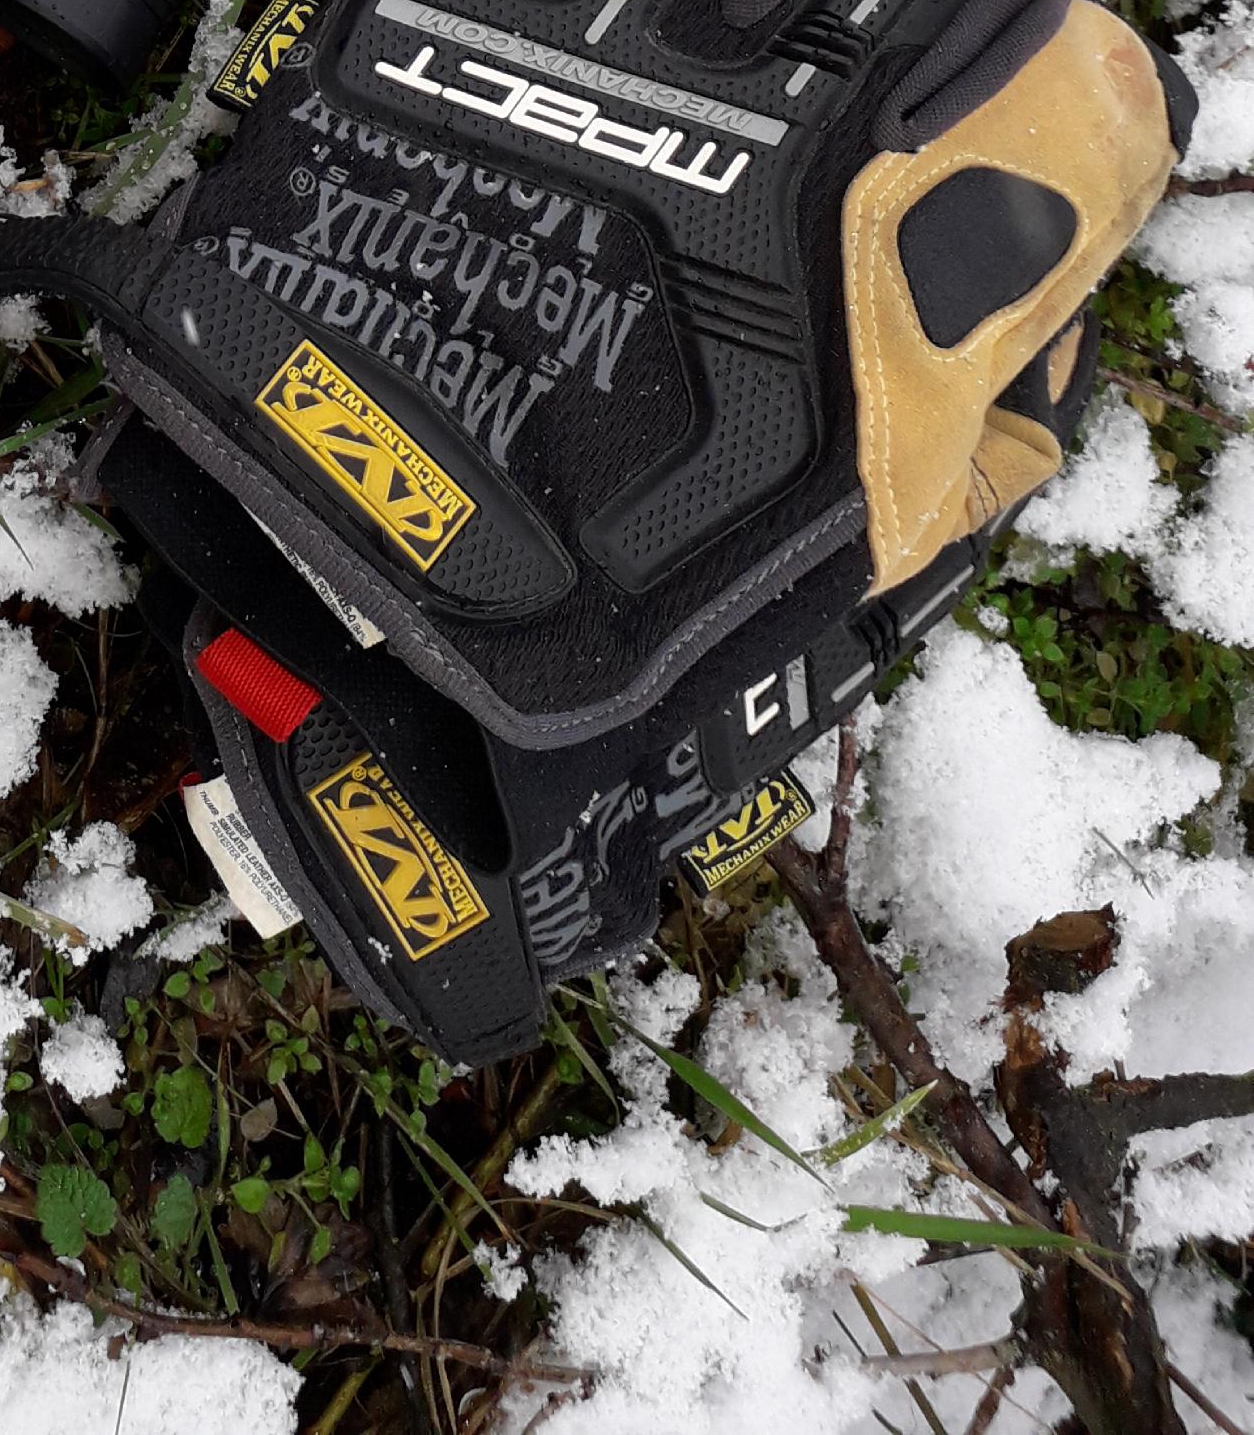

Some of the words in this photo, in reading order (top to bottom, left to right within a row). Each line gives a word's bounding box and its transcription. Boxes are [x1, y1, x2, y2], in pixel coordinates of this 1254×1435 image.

[219, 54, 249, 92] WEAR
[415, 7, 752, 133] MECHANIX.COM
[301, 355, 364, 414] WEAR
[360, 410, 463, 522] MECHANIX
[217, 818, 249, 854] SIMULATED
[245, 852, 274, 883] LEATHER
[226, 812, 252, 840] RUBBER
[703, 833, 771, 885] MECHANIX
[769, 799, 807, 838] WEAR
